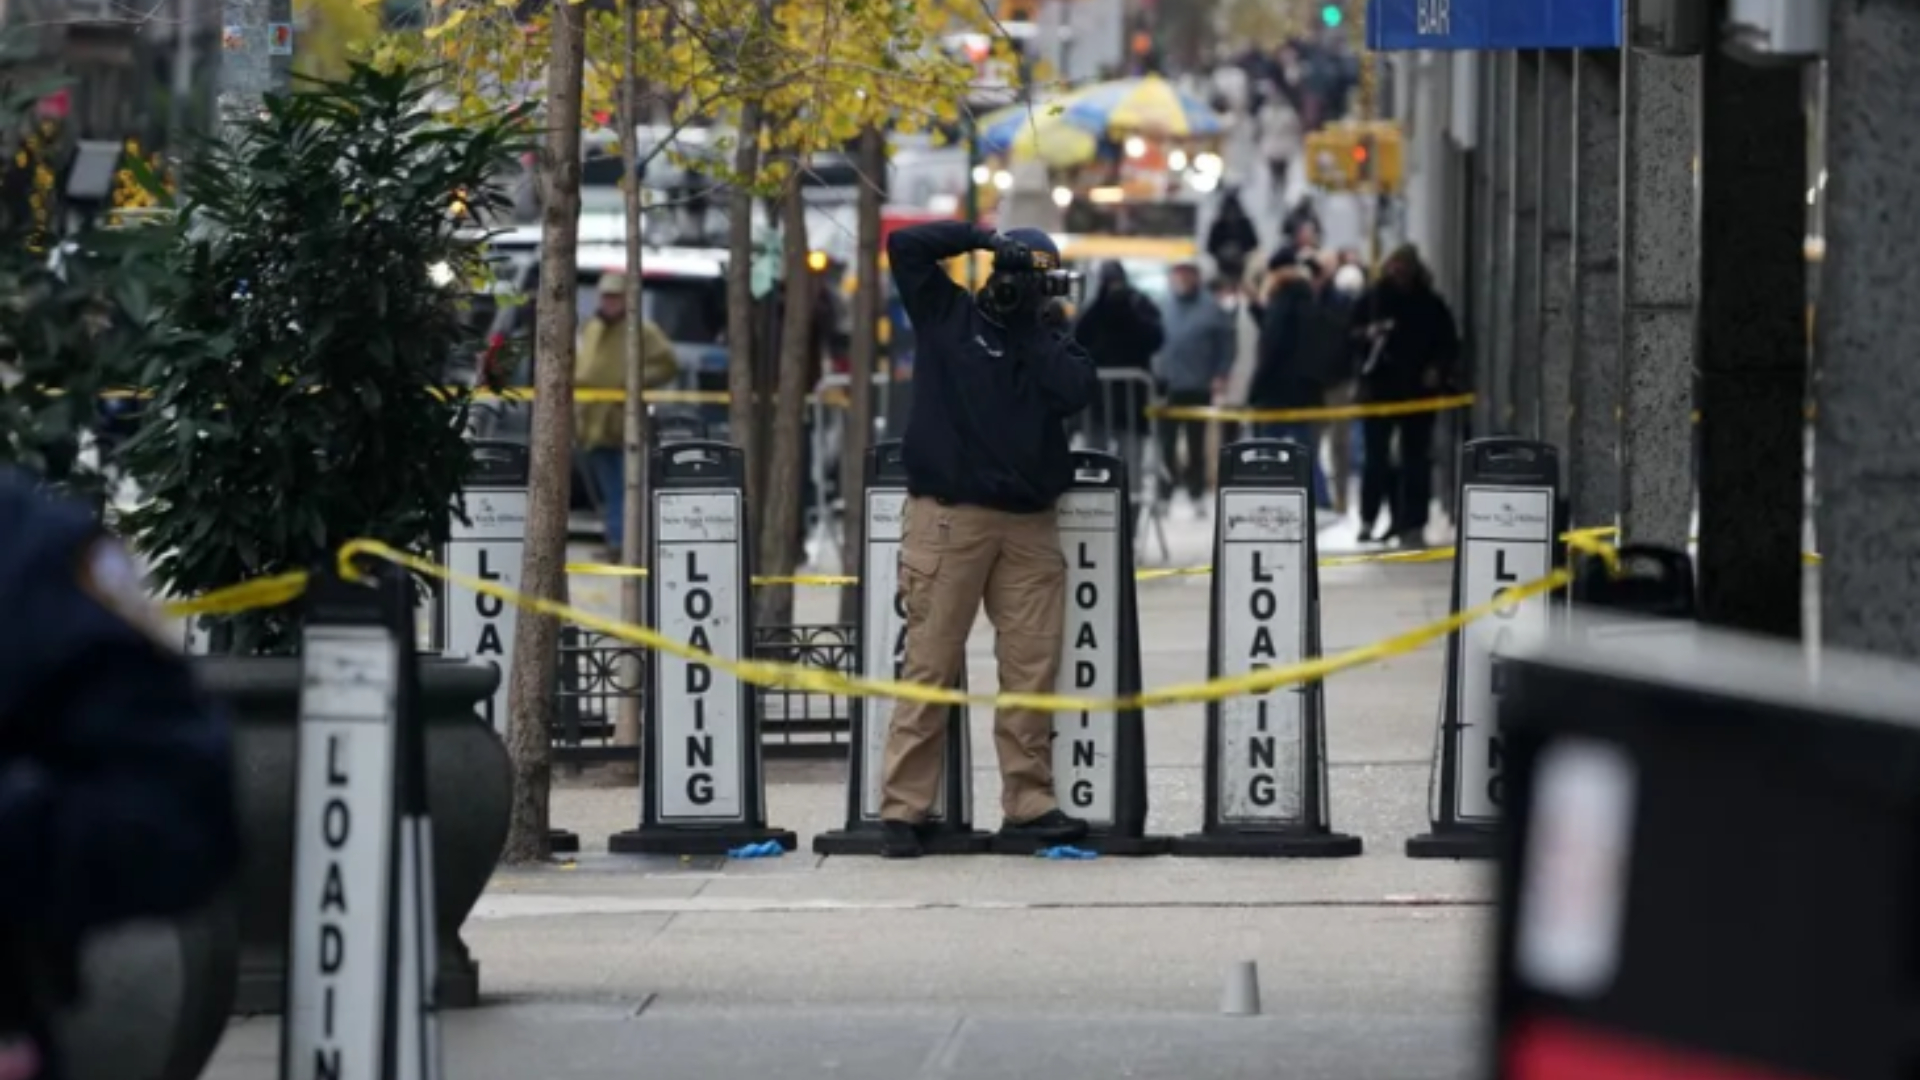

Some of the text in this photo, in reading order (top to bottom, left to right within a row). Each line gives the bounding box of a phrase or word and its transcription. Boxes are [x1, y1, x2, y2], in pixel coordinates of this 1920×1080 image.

[1417, 0, 1449, 34] BAR
[684, 551, 714, 805] LOADING
[1071, 542, 1099, 808] LOADING
